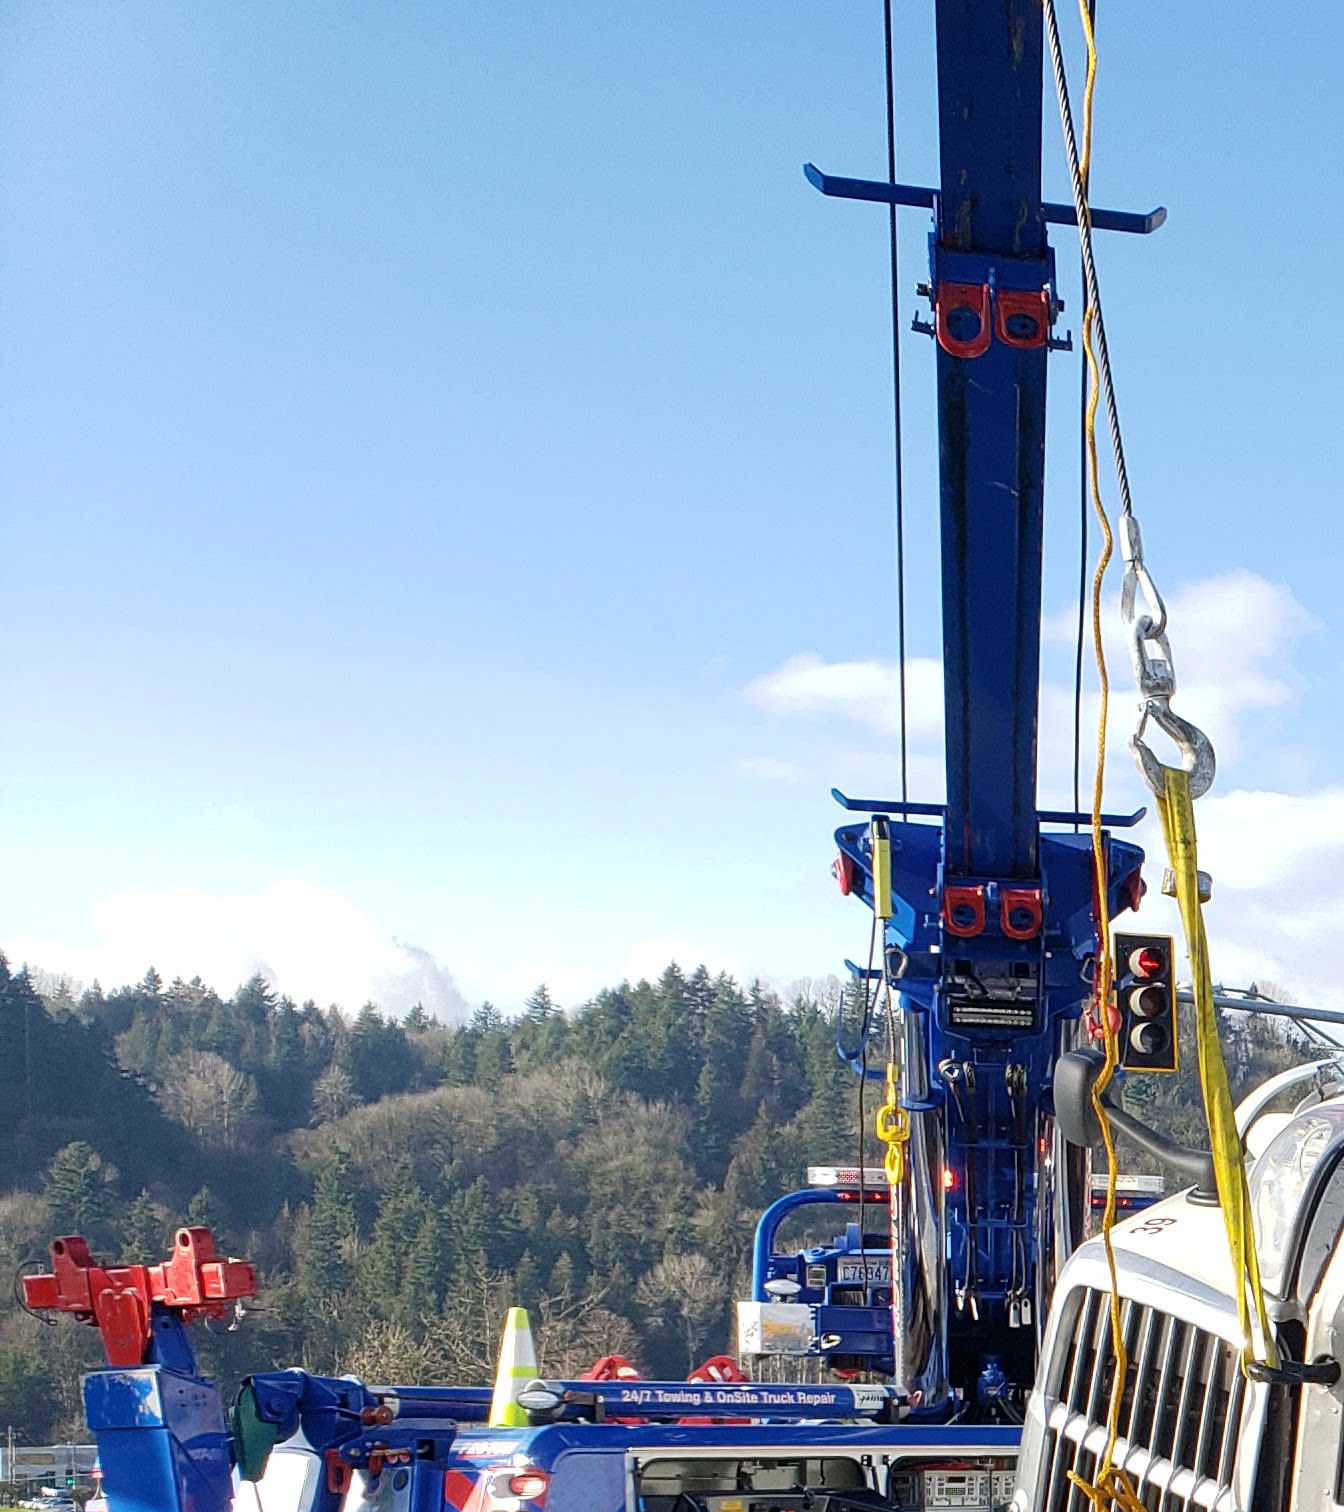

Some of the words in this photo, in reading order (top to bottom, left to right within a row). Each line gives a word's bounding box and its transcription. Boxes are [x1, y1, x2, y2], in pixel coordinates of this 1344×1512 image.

[1129, 1218, 1178, 1235] 39
[621, 1389, 652, 1405] 24/7
[655, 1389, 701, 1406] Towing
[704, 1390, 713, 1404] &
[716, 1390, 759, 1404] OnSite
[761, 1391, 795, 1404] Truck
[797, 1391, 836, 1406] Repair
